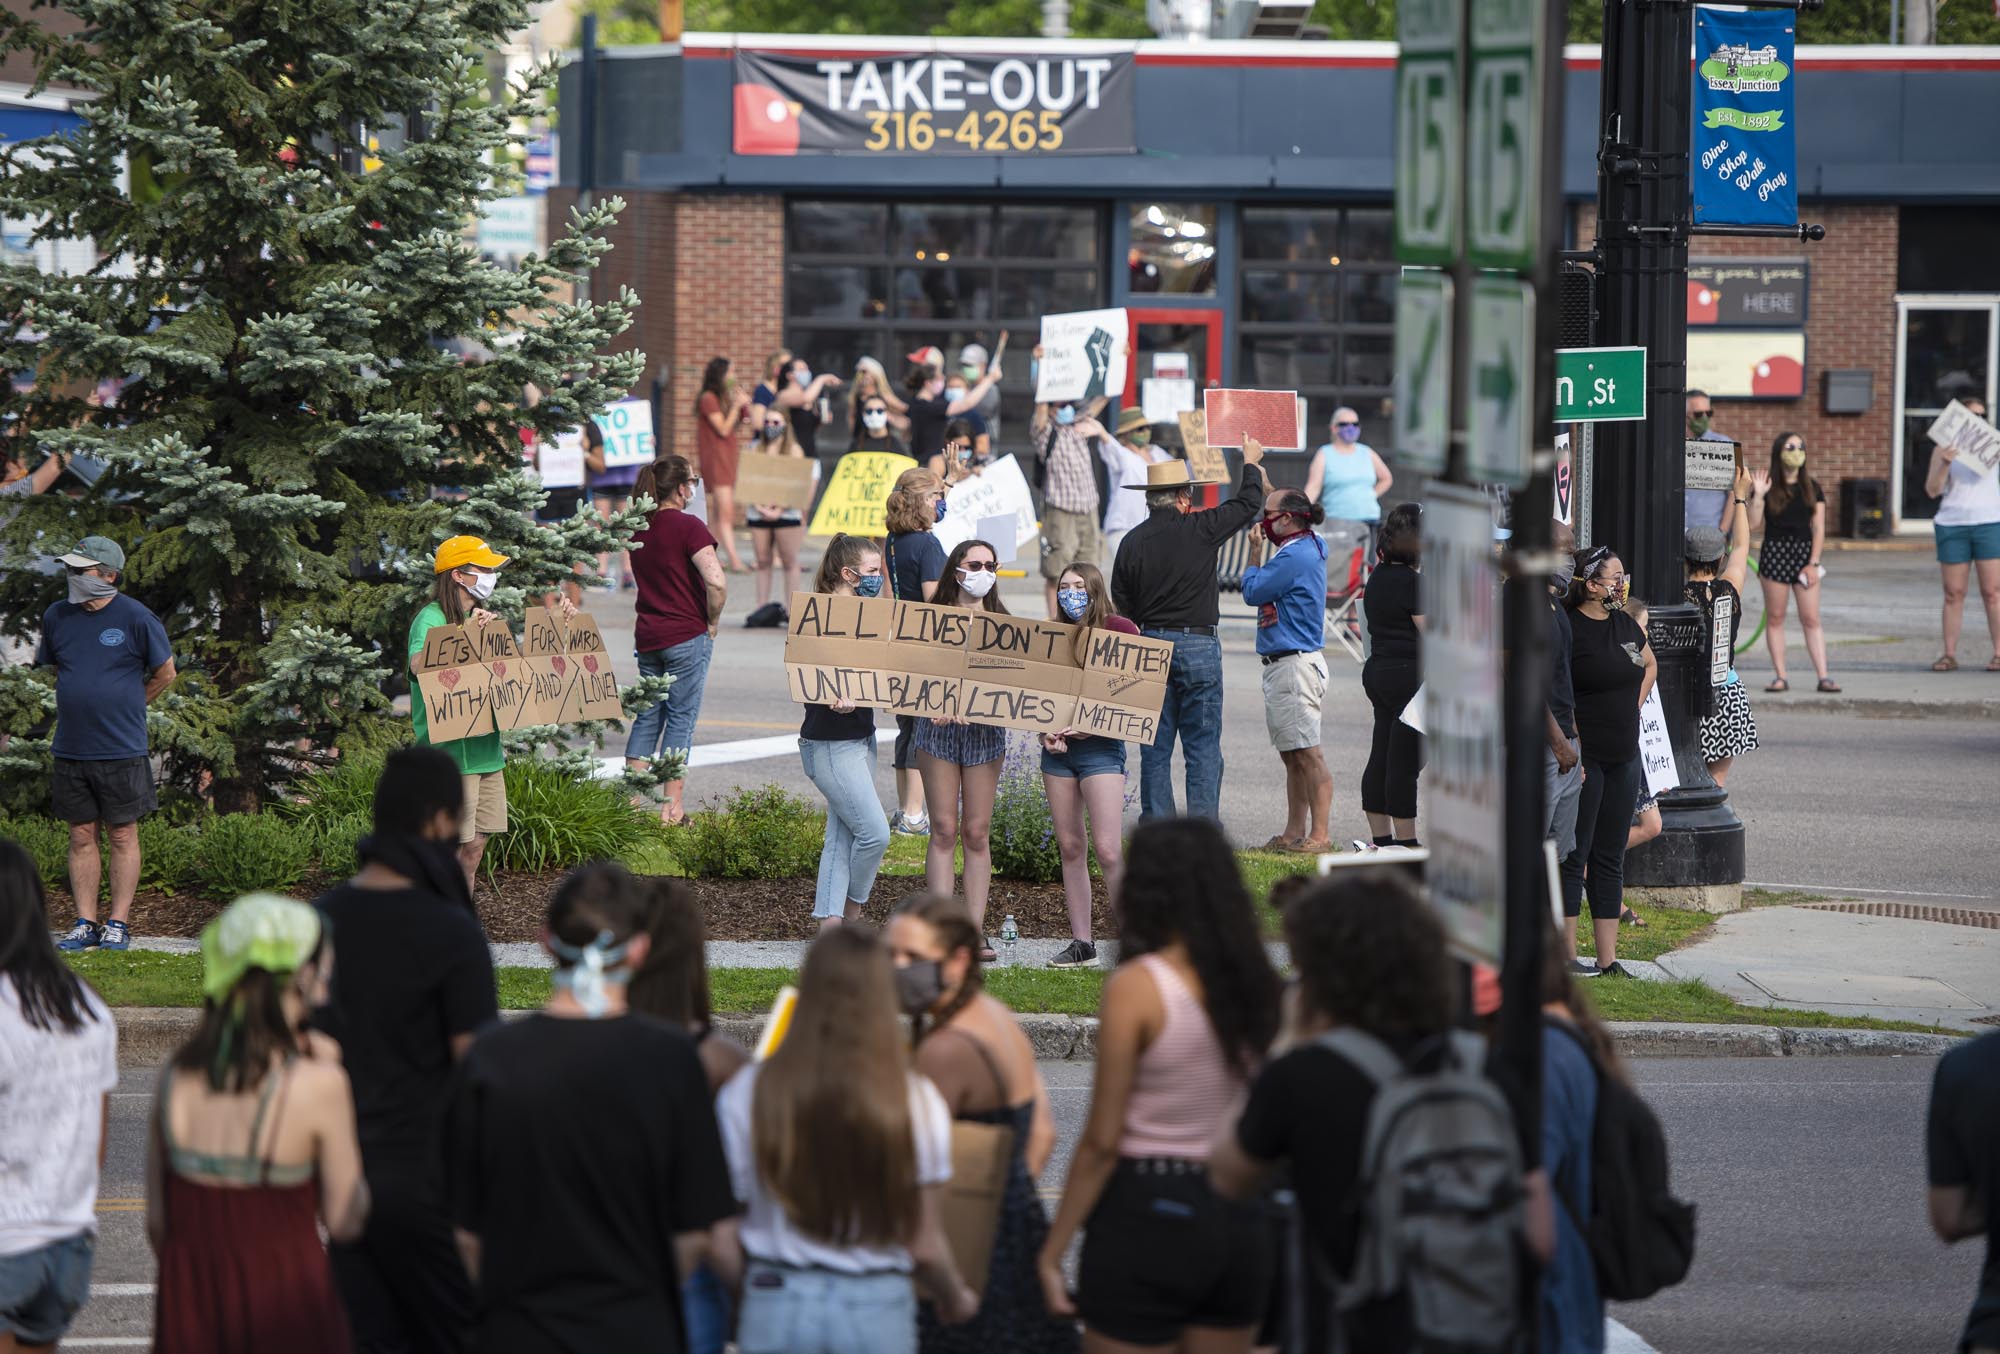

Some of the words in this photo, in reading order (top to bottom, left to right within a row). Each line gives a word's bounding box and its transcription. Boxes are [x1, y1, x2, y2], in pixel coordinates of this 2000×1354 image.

[817, 59, 1111, 112] TAKE-OUT
[1709, 77, 1734, 89] Essex
[1736, 78, 1778, 91] Junction
[1739, 67, 1764, 79] Village
[1766, 68, 1774, 79] of
[865, 110, 1064, 151] 316-4265
[1718, 112, 1737, 124] Est.
[1742, 114, 1770, 127] 1892
[1702, 139, 1728, 169] Dine
[1718, 150, 1747, 180] Shop
[1736, 158, 1766, 190] Walk
[1759, 171, 1788, 201] Play
[1742, 292, 1795, 313] HERE
[1593, 377, 1616, 405] St
[604, 432, 651, 456] ATE
[1700, 452, 1734, 462] TRANS
[841, 457, 893, 480] BLACK
[825, 506, 885, 526] MATTE
[424, 636, 471, 669] LETS
[484, 632, 513, 658] MOVE
[797, 597, 878, 638] ALL
[896, 603, 968, 646] LIVES
[975, 615, 1066, 659] DON'T
[1090, 635, 1170, 676] MATTER
[430, 685, 483, 724] WITH
[488, 678, 524, 711] UNITY
[535, 672, 562, 705] AND
[580, 671, 619, 705] LOVE!
[797, 666, 893, 703] UNTIL
[888, 673, 958, 715] BLACK
[965, 686, 1056, 724] LIVES
[1077, 702, 1153, 742] MATTER
[1640, 715, 1660, 734] Lives
[1644, 752, 1670, 774] Matter
